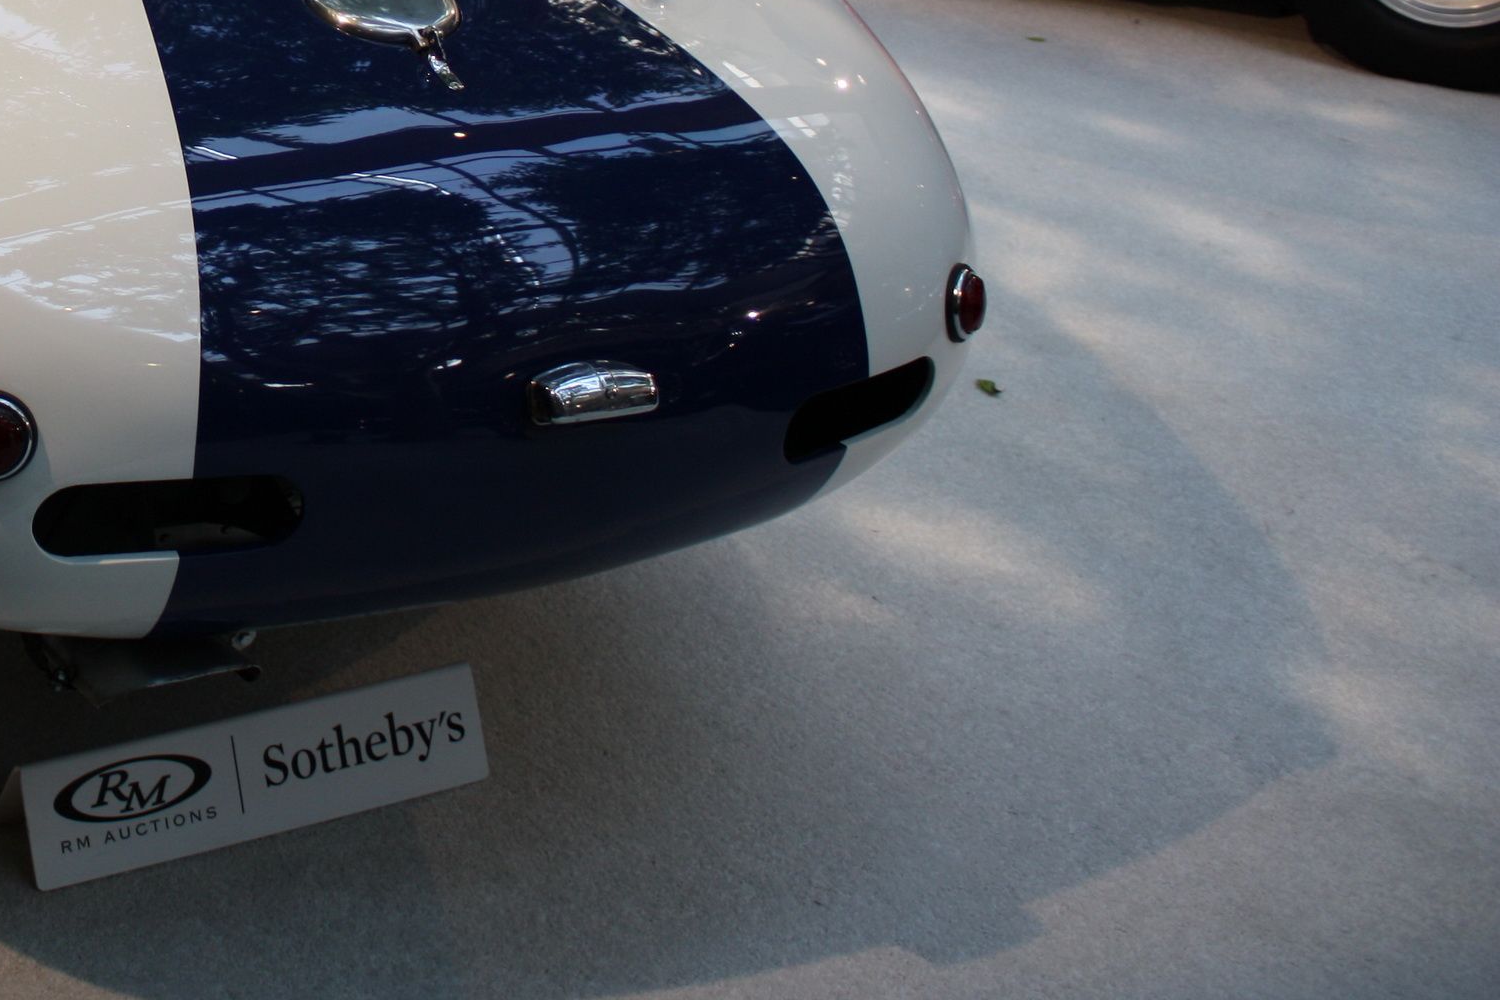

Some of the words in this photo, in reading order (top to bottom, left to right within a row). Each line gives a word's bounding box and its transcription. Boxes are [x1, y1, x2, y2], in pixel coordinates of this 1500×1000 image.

[262, 710, 466, 788] Sotheby's
[91, 769, 171, 813] RM
[60, 835, 91, 854] RM
[104, 806, 218, 844] AUCTIONS
